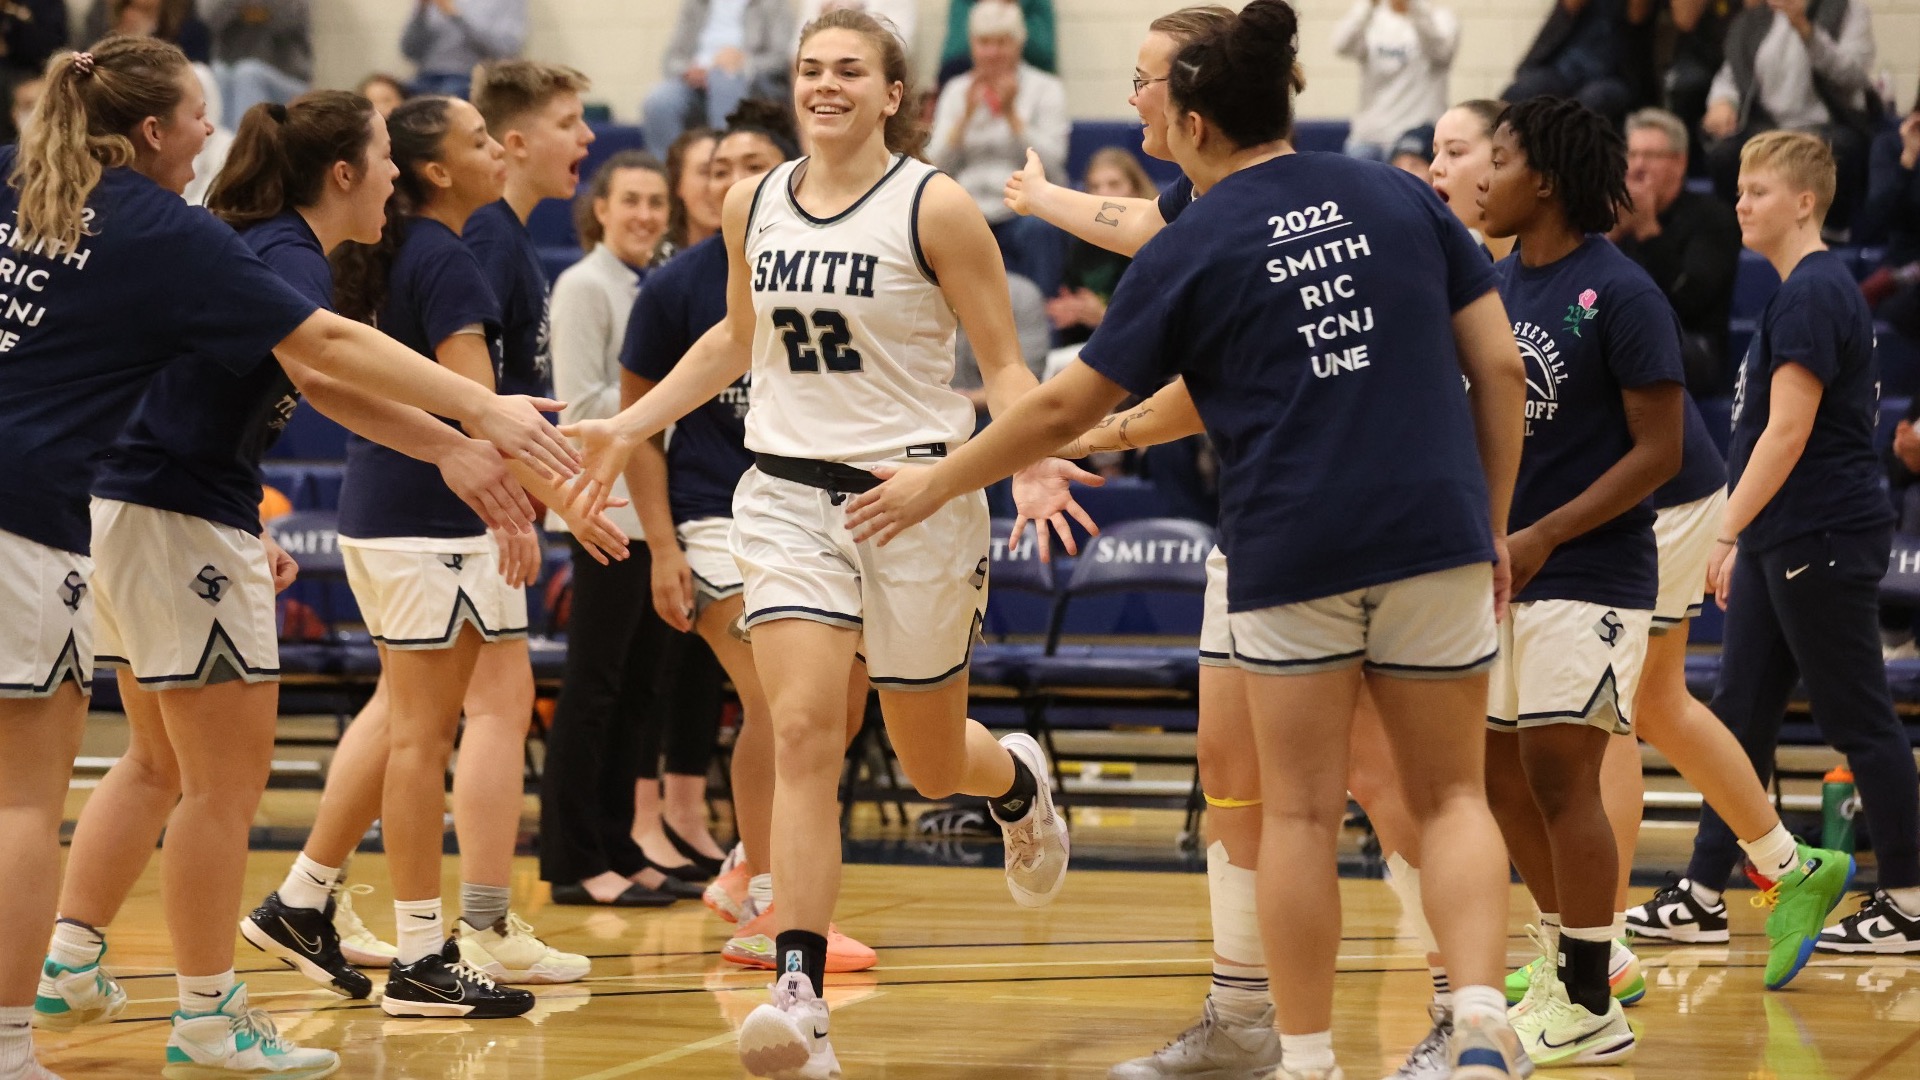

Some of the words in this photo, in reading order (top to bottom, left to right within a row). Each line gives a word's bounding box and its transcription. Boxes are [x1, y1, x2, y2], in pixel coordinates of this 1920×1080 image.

[1267, 201, 1344, 238] 2022
[0, 257, 50, 292] RIC
[754, 250, 879, 298] SMITH
[1266, 234, 1371, 283] SMITH
[1300, 274, 1355, 311] RIC
[771, 307, 864, 374] 22
[1297, 307, 1374, 348] TCNJ
[1311, 344, 1370, 378] UNE
[1512, 321, 1569, 384] SKETBALL
[280, 530, 337, 554] MIT
[1096, 536, 1203, 564] SMITH
